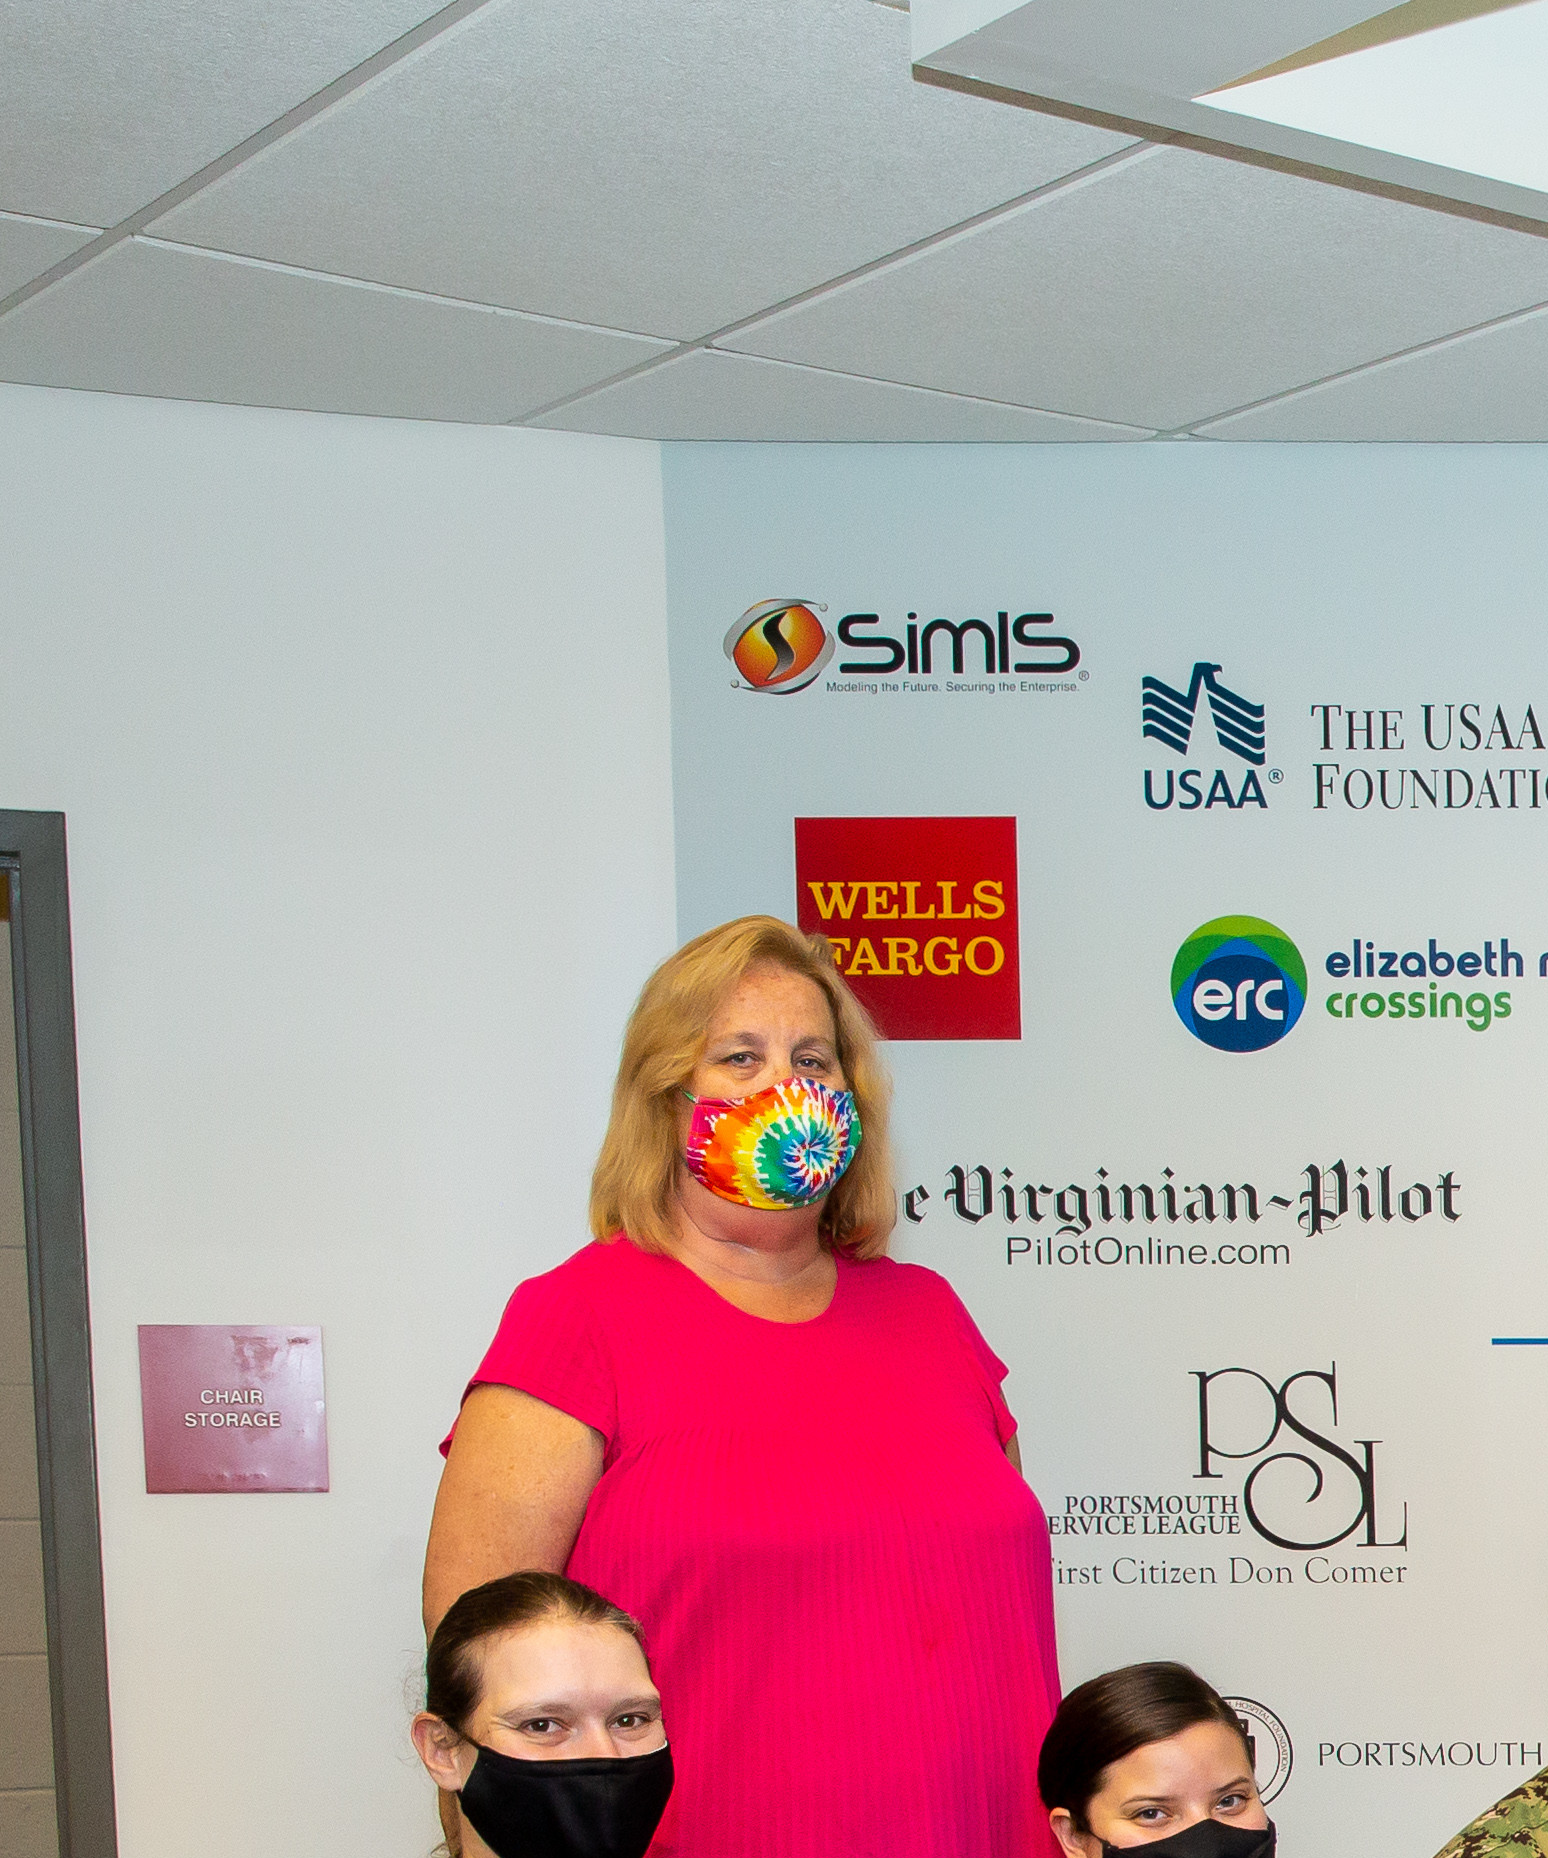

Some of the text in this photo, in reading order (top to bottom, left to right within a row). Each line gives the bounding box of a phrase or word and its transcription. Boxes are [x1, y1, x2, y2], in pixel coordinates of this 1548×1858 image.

[837, 611, 1081, 674] SimIS
[826, 681, 1080, 694] Modeling the Future. Securing the Enterprise.
[1421, 703, 1547, 750] USAA
[1144, 770, 1268, 809] USAA
[807, 880, 1006, 920] WELLS
[1325, 938, 1523, 978] elizabeth
[1192, 979, 1284, 1021] erc
[1326, 982, 1512, 1032] crossings
[1006, 1237, 1290, 1265] PilotOnline.com
[200, 1389, 264, 1405] CHAIR
[184, 1412, 281, 1427] STORAGE
[1065, 1495, 1239, 1514] PORTSMOUTH
[1048, 1515, 1241, 1535] ERVICE LEAGUE
[1051, 1556, 1408, 1585] irst Citizen Don Comer
[1319, 1742, 1542, 1766] PORTSMOUTH
